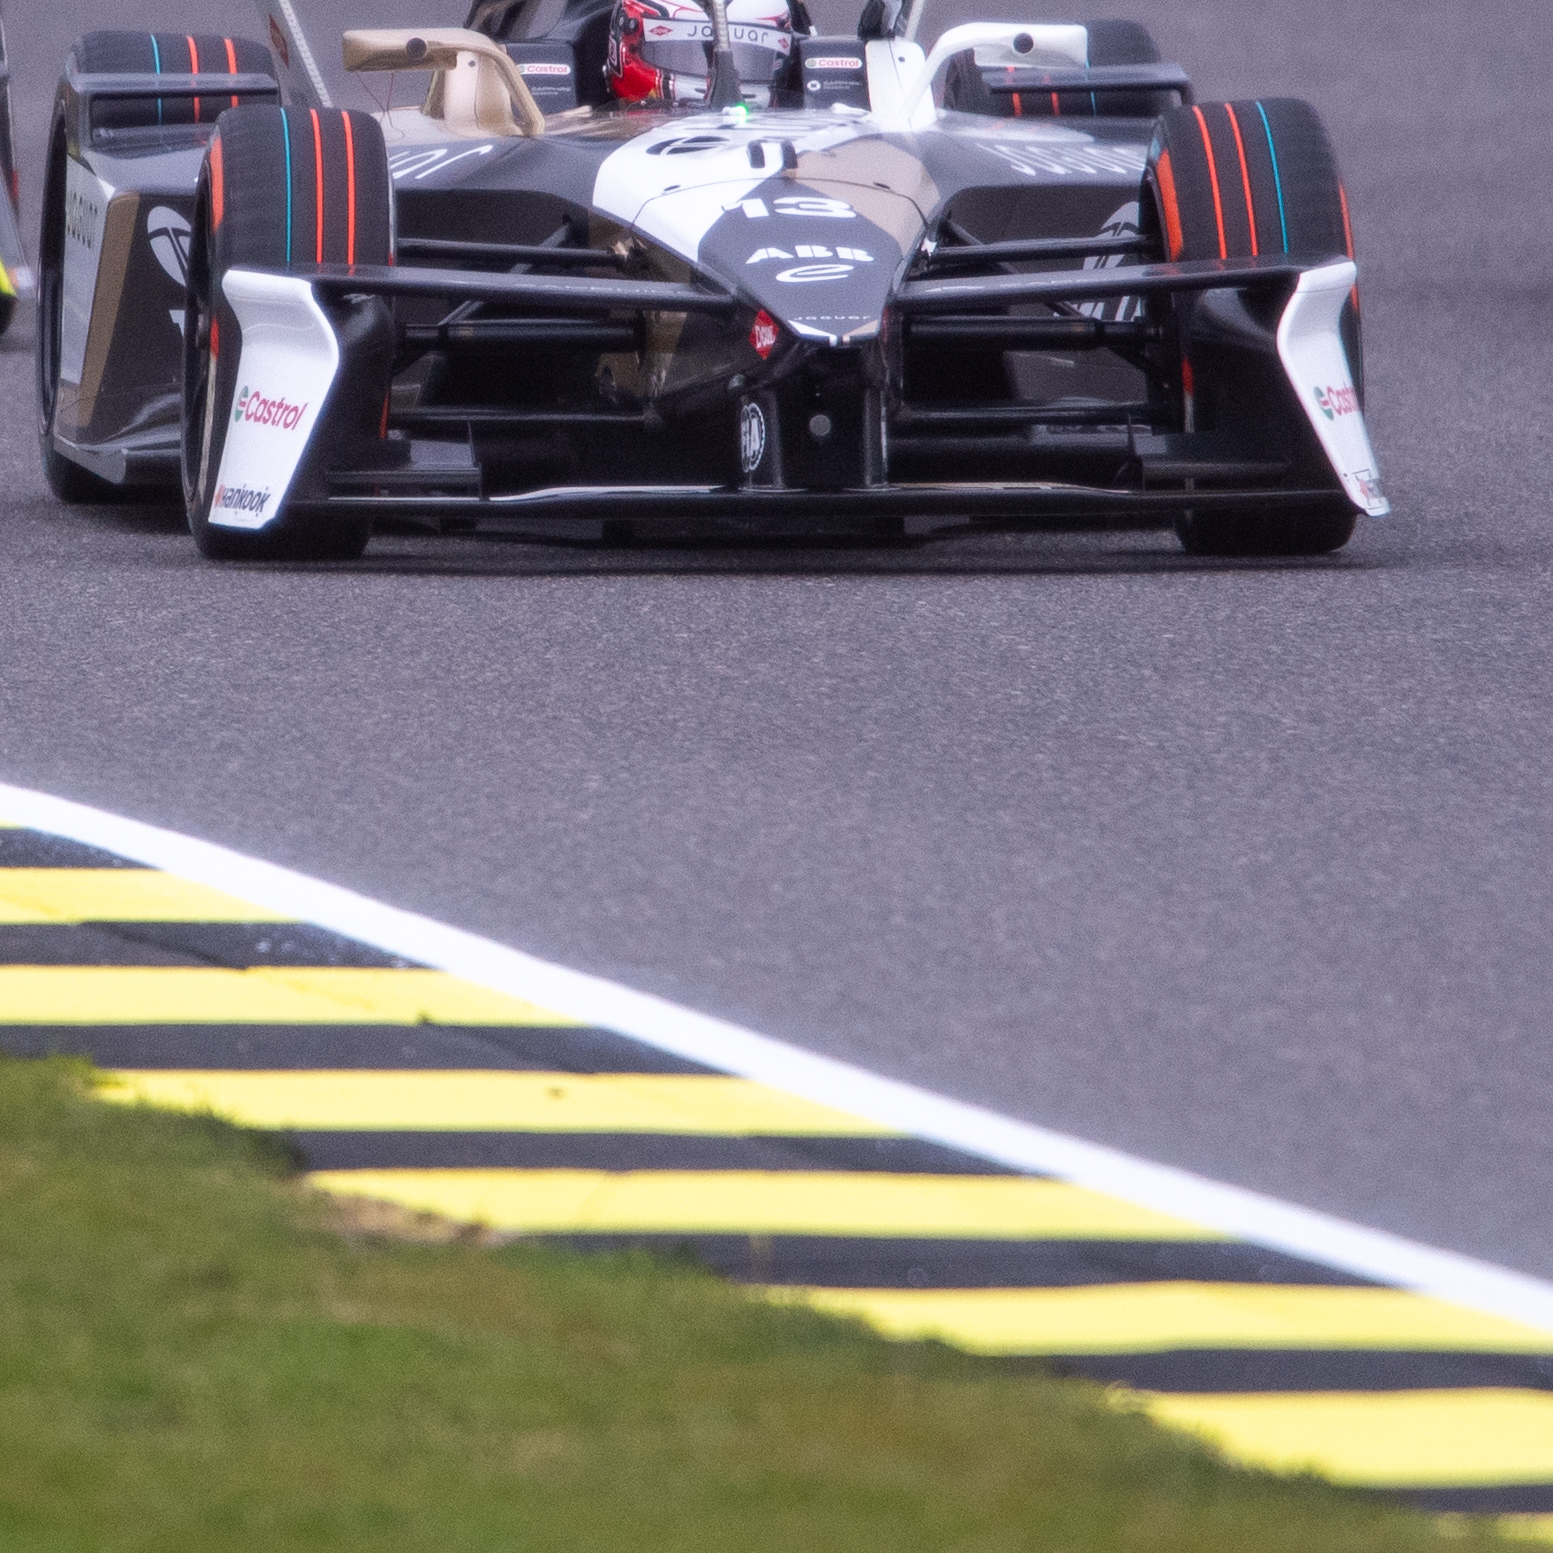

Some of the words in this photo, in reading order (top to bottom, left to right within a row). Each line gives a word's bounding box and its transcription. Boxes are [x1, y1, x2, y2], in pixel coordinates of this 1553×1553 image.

[527, 65, 568, 73] Castrol
[819, 58, 859, 67] Castrol
[721, 196, 856, 218] 13
[745, 245, 875, 264] ABB
[244, 390, 309, 432] Castrol
